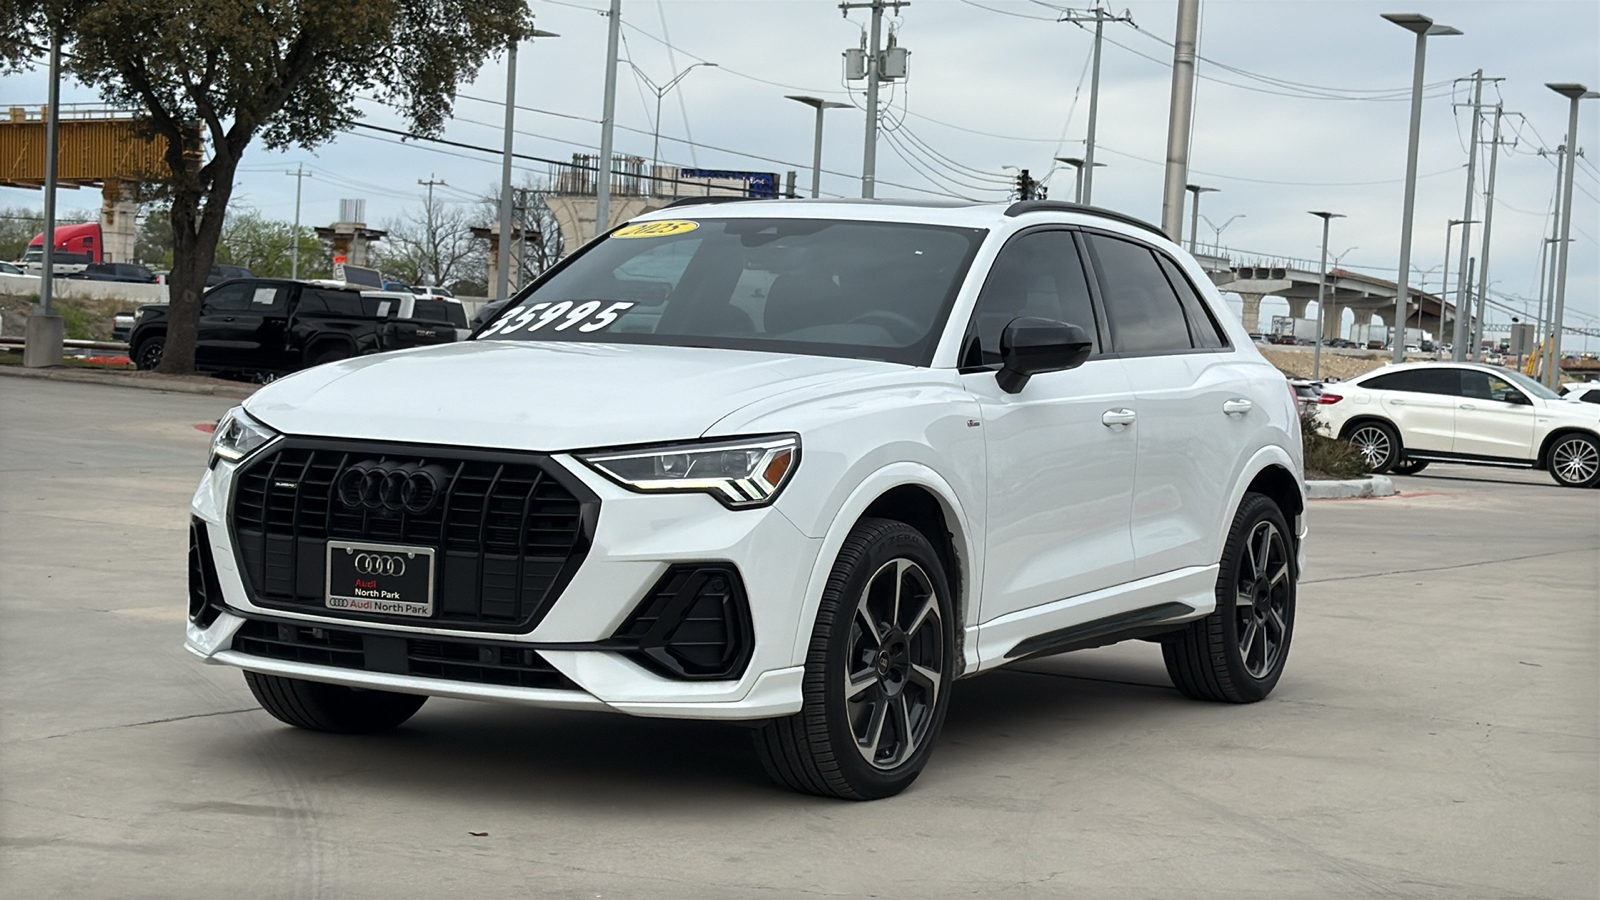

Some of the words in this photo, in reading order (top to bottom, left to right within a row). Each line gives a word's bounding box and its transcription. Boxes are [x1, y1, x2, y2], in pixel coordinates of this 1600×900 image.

[620, 222, 689, 235] 2025
[476, 300, 634, 340] 35995
[354, 579, 377, 588] Audi
[354, 588, 379, 597] North
[381, 590, 400, 599] Park
[349, 600, 373, 609] Audi
[374, 602, 404, 612] North
[405, 604, 428, 614] Park
